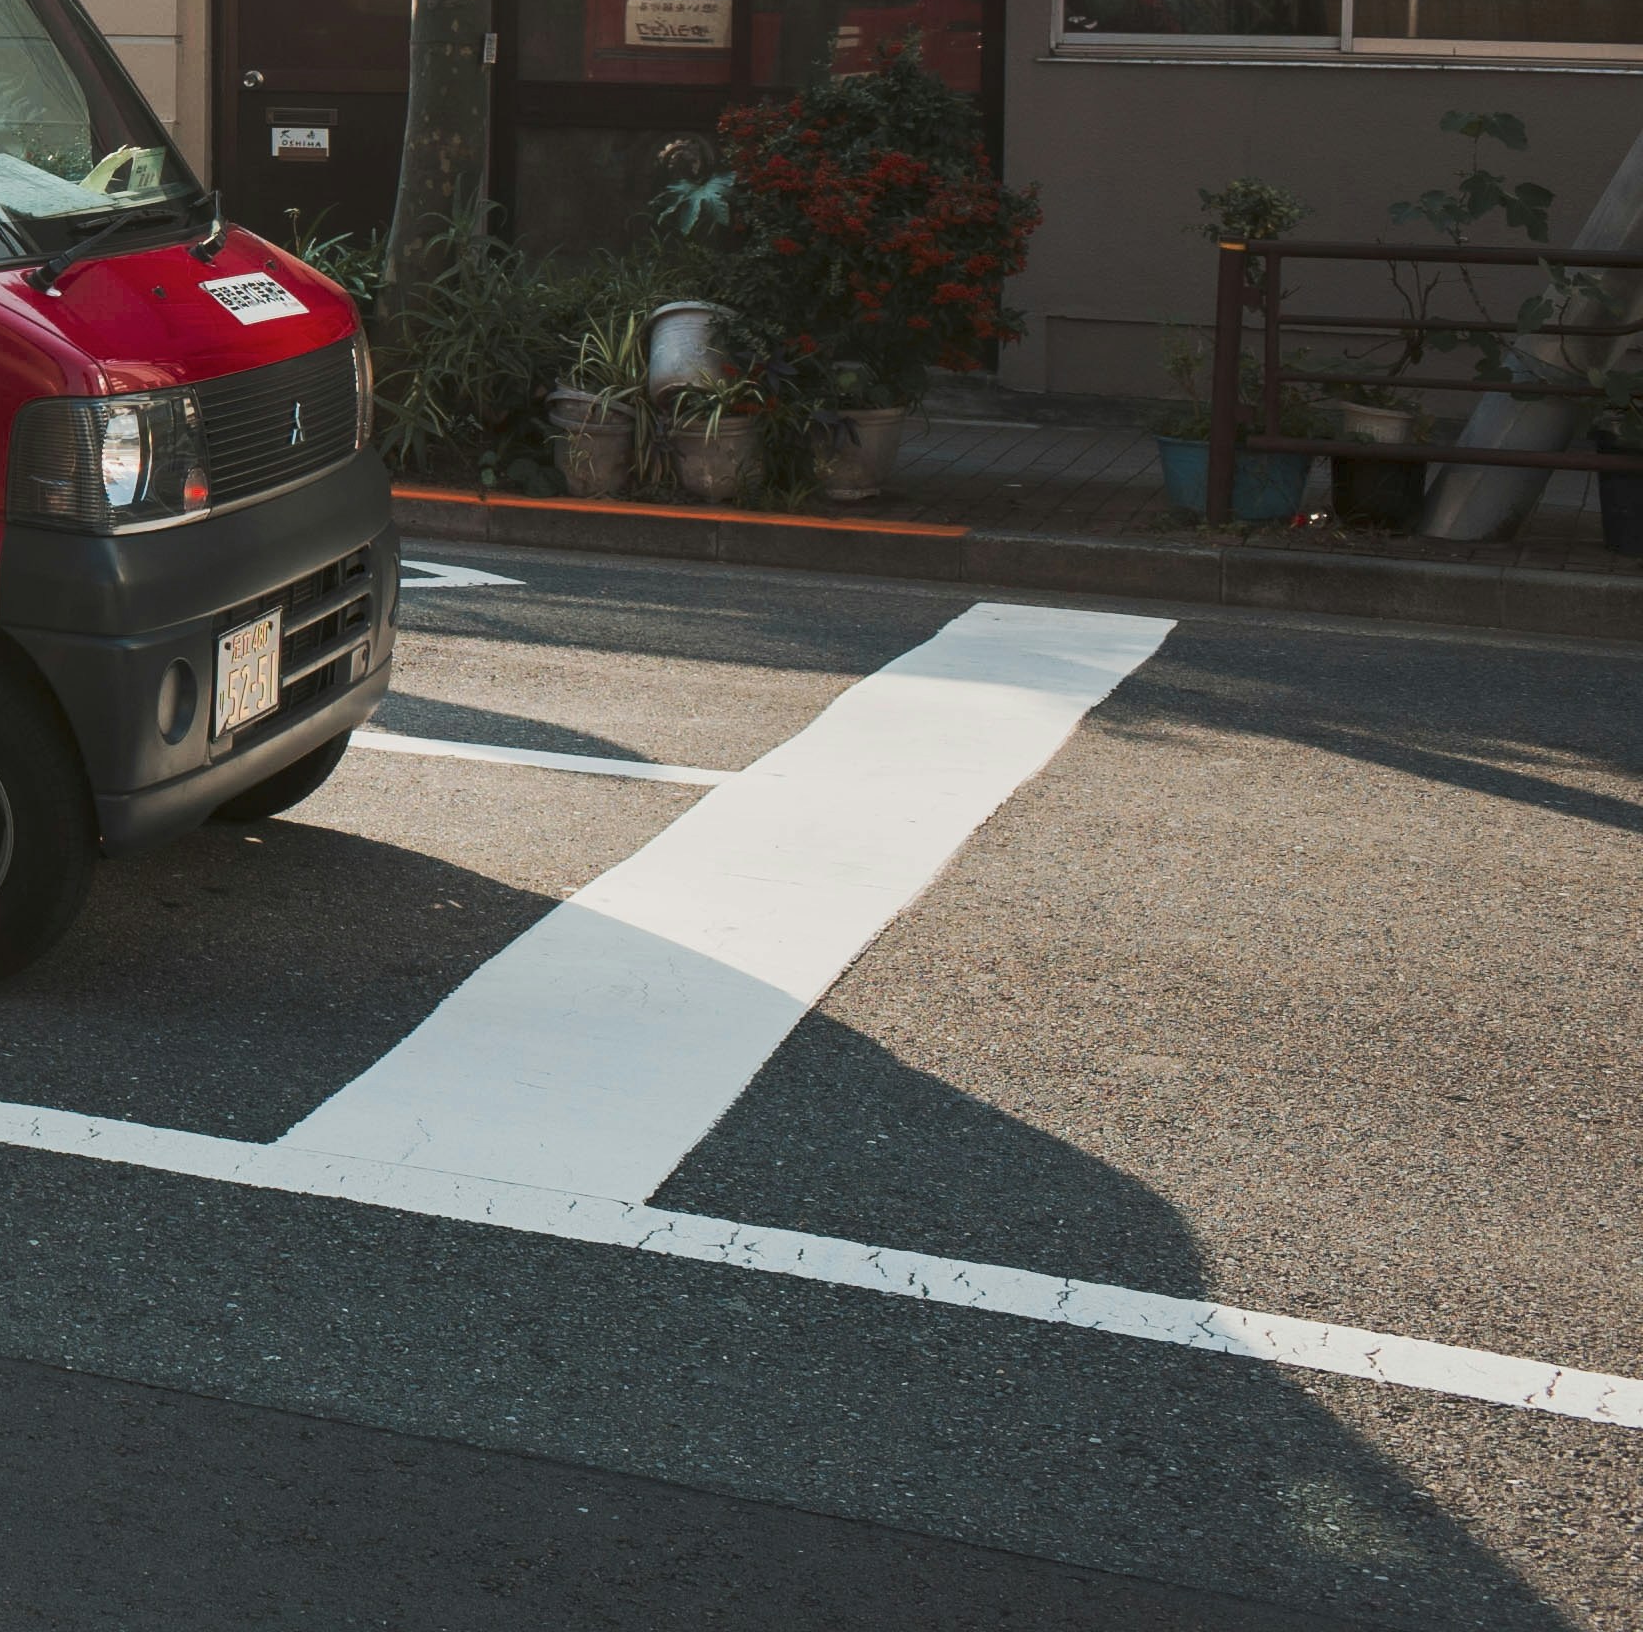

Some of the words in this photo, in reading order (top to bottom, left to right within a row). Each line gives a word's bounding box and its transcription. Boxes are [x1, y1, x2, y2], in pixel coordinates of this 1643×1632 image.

[281, 139, 322, 148] OSHIMA
[232, 632, 252, 662] 足立
[253, 621, 269, 652] 480
[227, 649, 277, 726] 52-51
